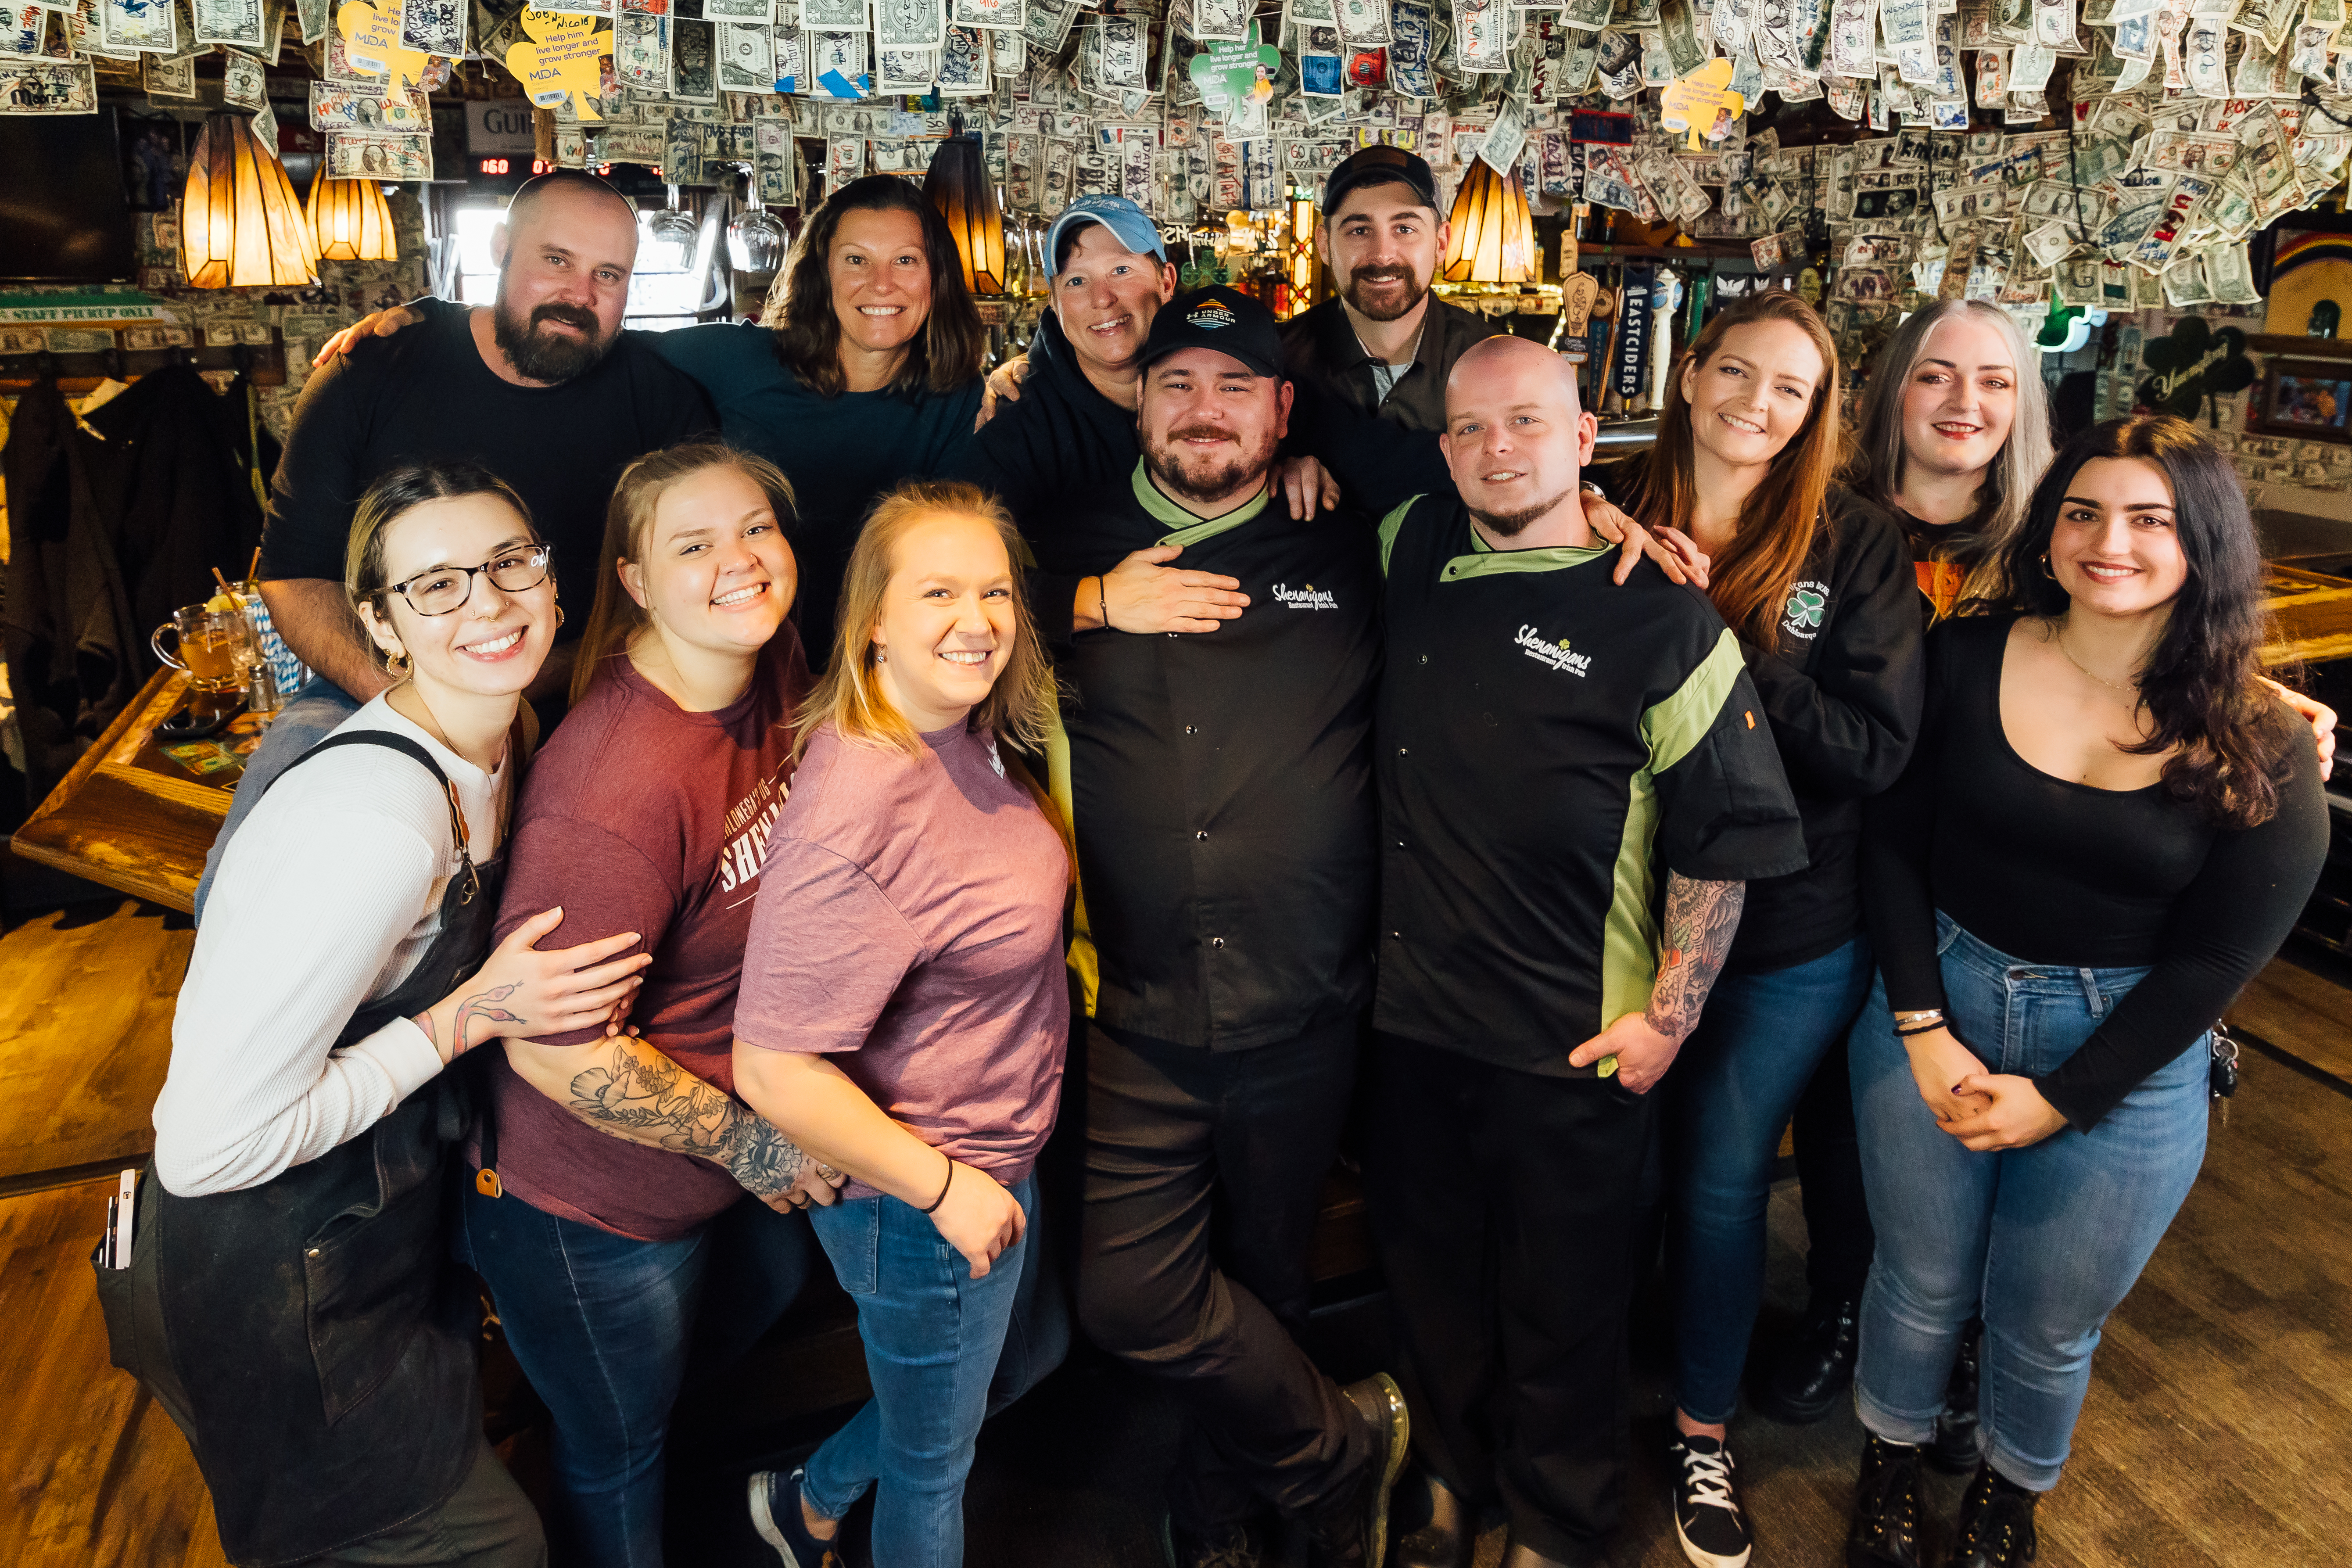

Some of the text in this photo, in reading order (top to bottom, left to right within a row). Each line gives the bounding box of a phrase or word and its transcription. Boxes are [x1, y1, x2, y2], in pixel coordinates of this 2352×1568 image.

[371, 24, 396, 35] grow
[545, 30, 584, 44] Help him
[355, 32, 389, 49] MDA
[535, 38, 599, 55] live longer and
[539, 47, 601, 67] grow stronger
[1210, 50, 1258, 63] live longer and
[1218, 45, 1233, 54] Help
[1211, 59, 1258, 73] grow stronger
[529, 67, 562, 82] MDA
[1203, 75, 1227, 85] MDA
[482, 159, 509, 174] 160
[1201, 313, 1236, 323] ARMOUR
[1622, 298, 1643, 394] EASTCIDERS
[1272, 583, 1334, 611] Shenanigans
[1514, 624, 1592, 670] Shenanigans
[1524, 649, 1586, 678] Restaurant Irish Pub
